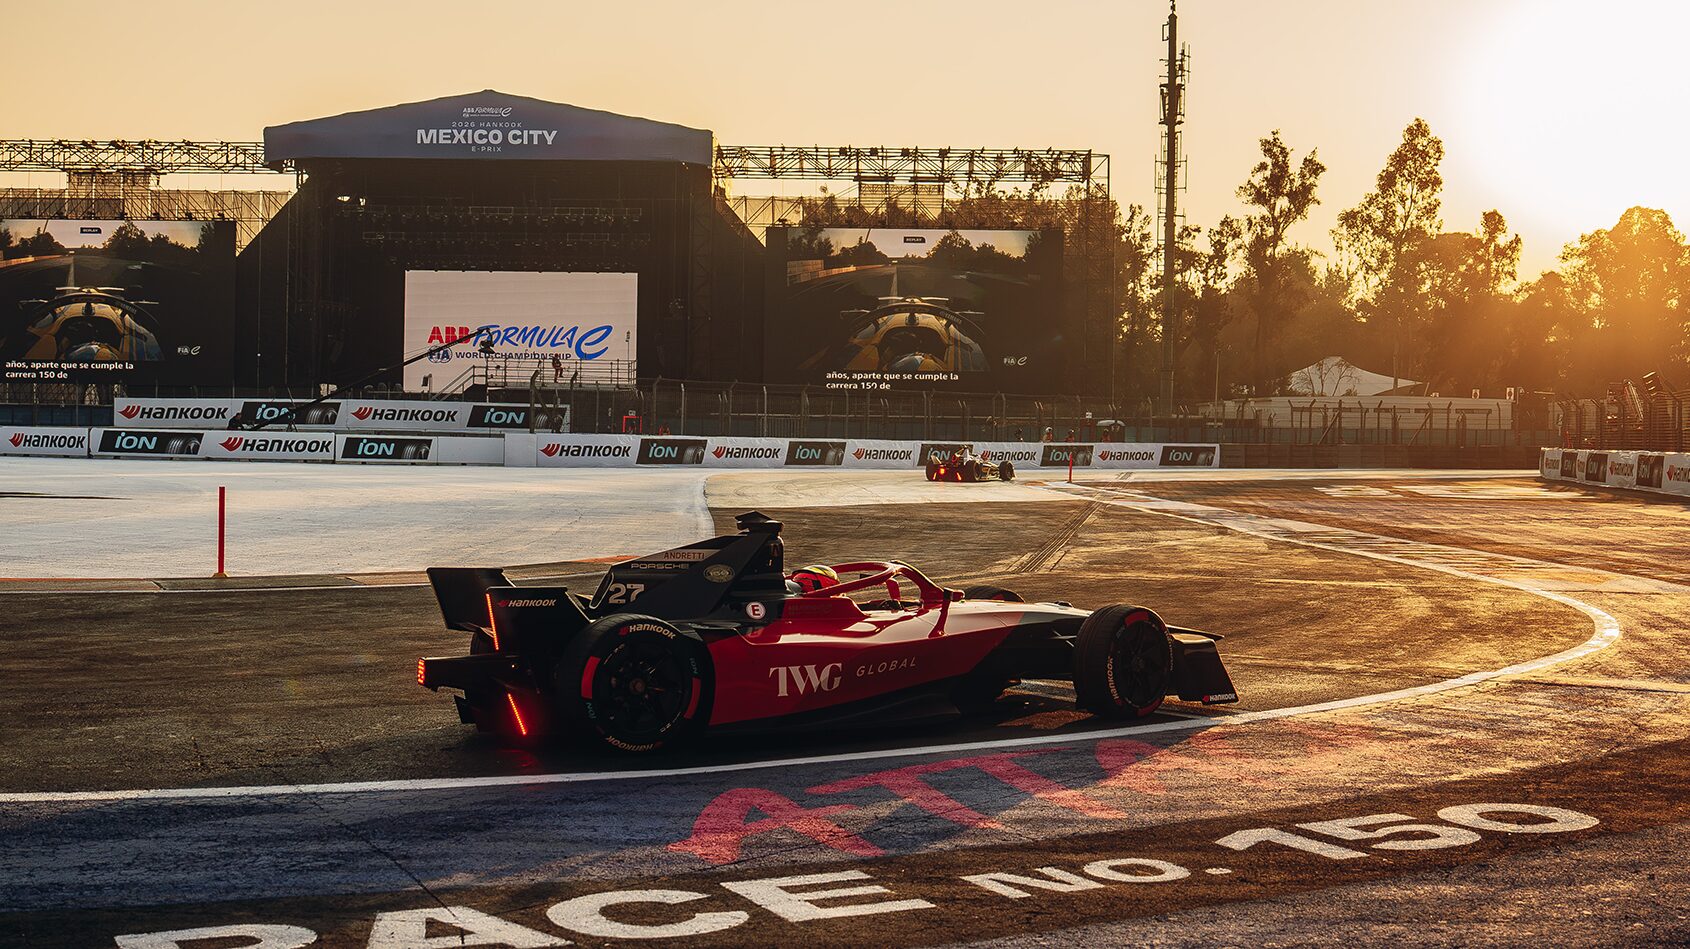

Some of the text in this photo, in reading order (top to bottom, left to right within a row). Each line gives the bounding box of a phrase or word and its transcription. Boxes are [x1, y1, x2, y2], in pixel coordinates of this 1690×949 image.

[416, 129, 558, 145] MEXICO CITY
[427, 326, 471, 344] ABB
[472, 325, 579, 348] FORMULA
[429, 349, 450, 360] FIA
[494, 352, 572, 360] CHAMPIONSHIP
[1003, 357, 1016, 365] FIA
[5, 361, 29, 370] años,
[30, 362, 59, 371] aparte
[61, 363, 78, 371] que
[91, 362, 124, 371] cumple
[39, 371, 55, 379] 150
[57, 371, 68, 379] de
[826, 371, 850, 381] años,
[852, 372, 881, 382] aparte
[883, 373, 901, 382] que
[914, 372, 948, 382] cumple
[950, 373, 959, 381] la
[861, 382, 878, 390] 150
[879, 382, 891, 390] de
[140, 405, 229, 420] HANKOOK
[372, 408, 458, 422] HANKOOK
[484, 408, 525, 424] iON
[22, 434, 86, 449] HANKOOK
[114, 431, 158, 449] iON
[241, 437, 332, 453] HANKOOK
[357, 438, 395, 456] iON
[558, 444, 631, 458] HANKOOK
[648, 443, 678, 458] iON
[724, 446, 781, 459] HANKOOK
[795, 445, 821, 459] iON
[864, 449, 913, 460] HANKOOK
[927, 447, 951, 460] iON
[990, 450, 1037, 461] HANKOOK
[1049, 449, 1072, 461] iON
[1109, 451, 1154, 462] HANKOOK
[1169, 449, 1192, 461] iON
[663, 551, 705, 560] ANDRETTI
[608, 583, 645, 604] 27
[508, 599, 557, 608] HANKOOK
[751, 604, 761, 616] E
[628, 623, 678, 640] HANKOOK
[856, 656, 917, 678] GLOBAL
[768, 663, 842, 697] TWG
[1106, 655, 1119, 700] HANKOOK
[605, 735, 656, 752] HANKOOK
[1214, 802, 1600, 860] 150
